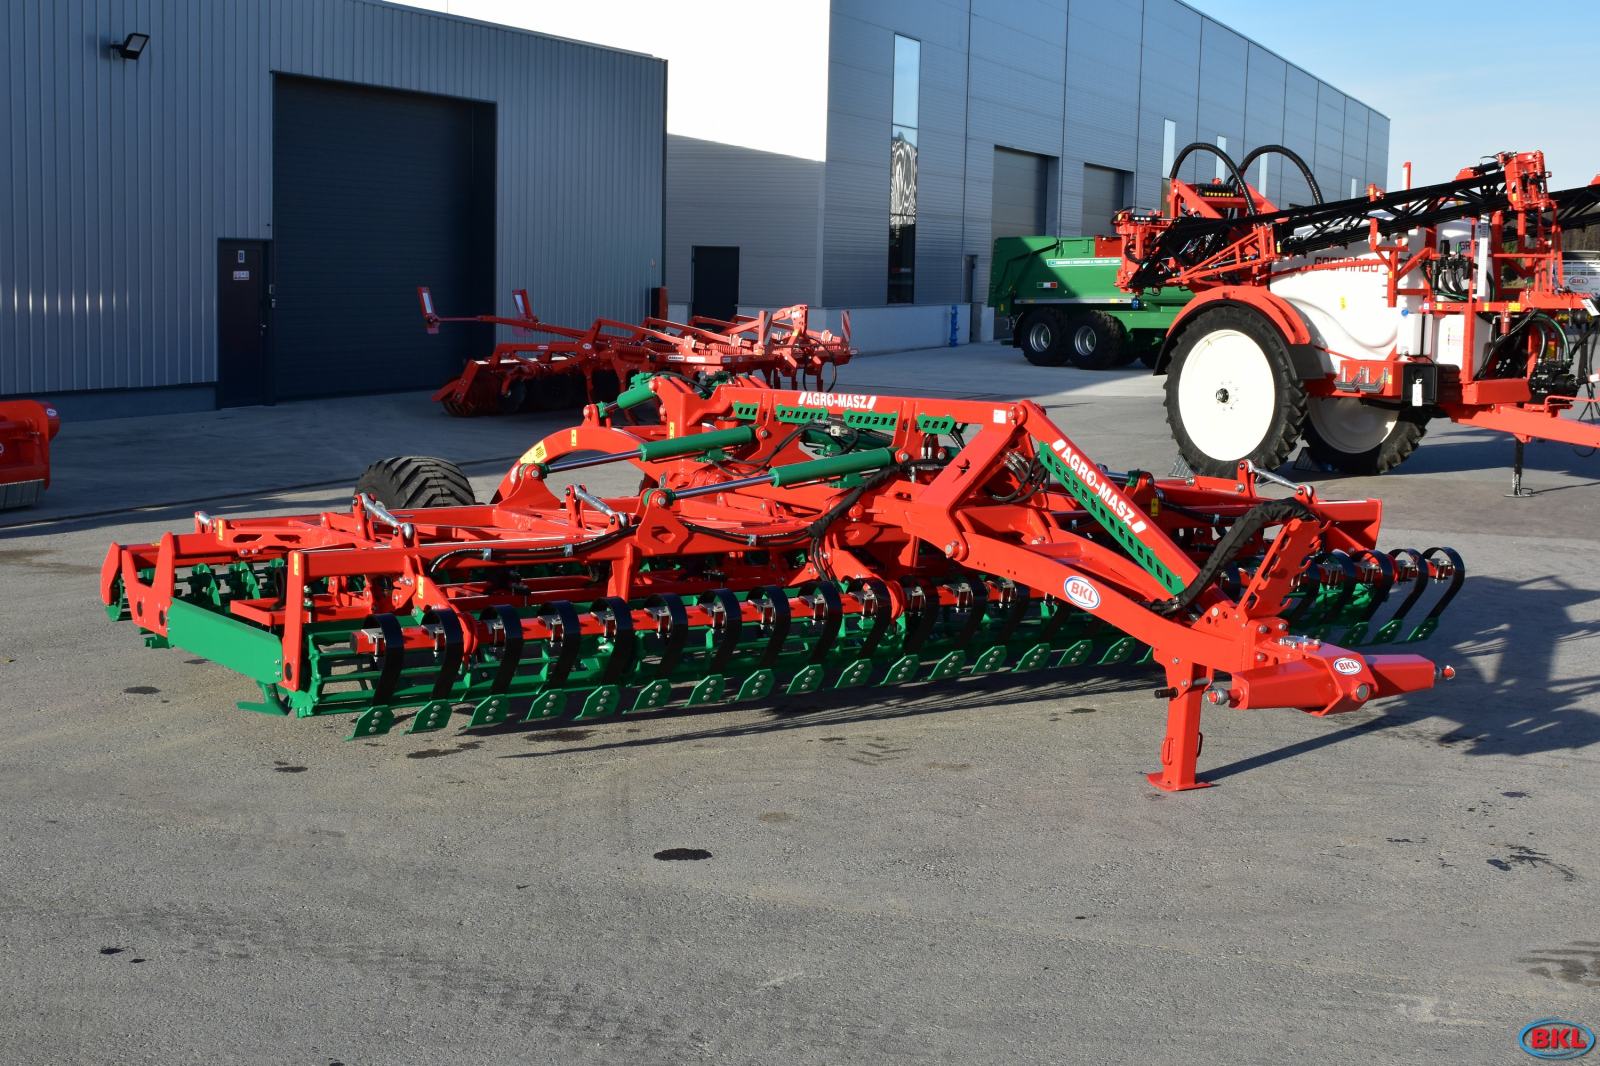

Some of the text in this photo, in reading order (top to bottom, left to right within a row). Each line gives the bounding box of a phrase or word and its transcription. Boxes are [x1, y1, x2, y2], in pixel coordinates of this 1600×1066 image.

[806, 392, 867, 409] AGRO-MASZ
[1061, 447, 1138, 526] AGRO-MASZ
[1069, 581, 1095, 604] BKL
[1338, 661, 1358, 671] BKL
